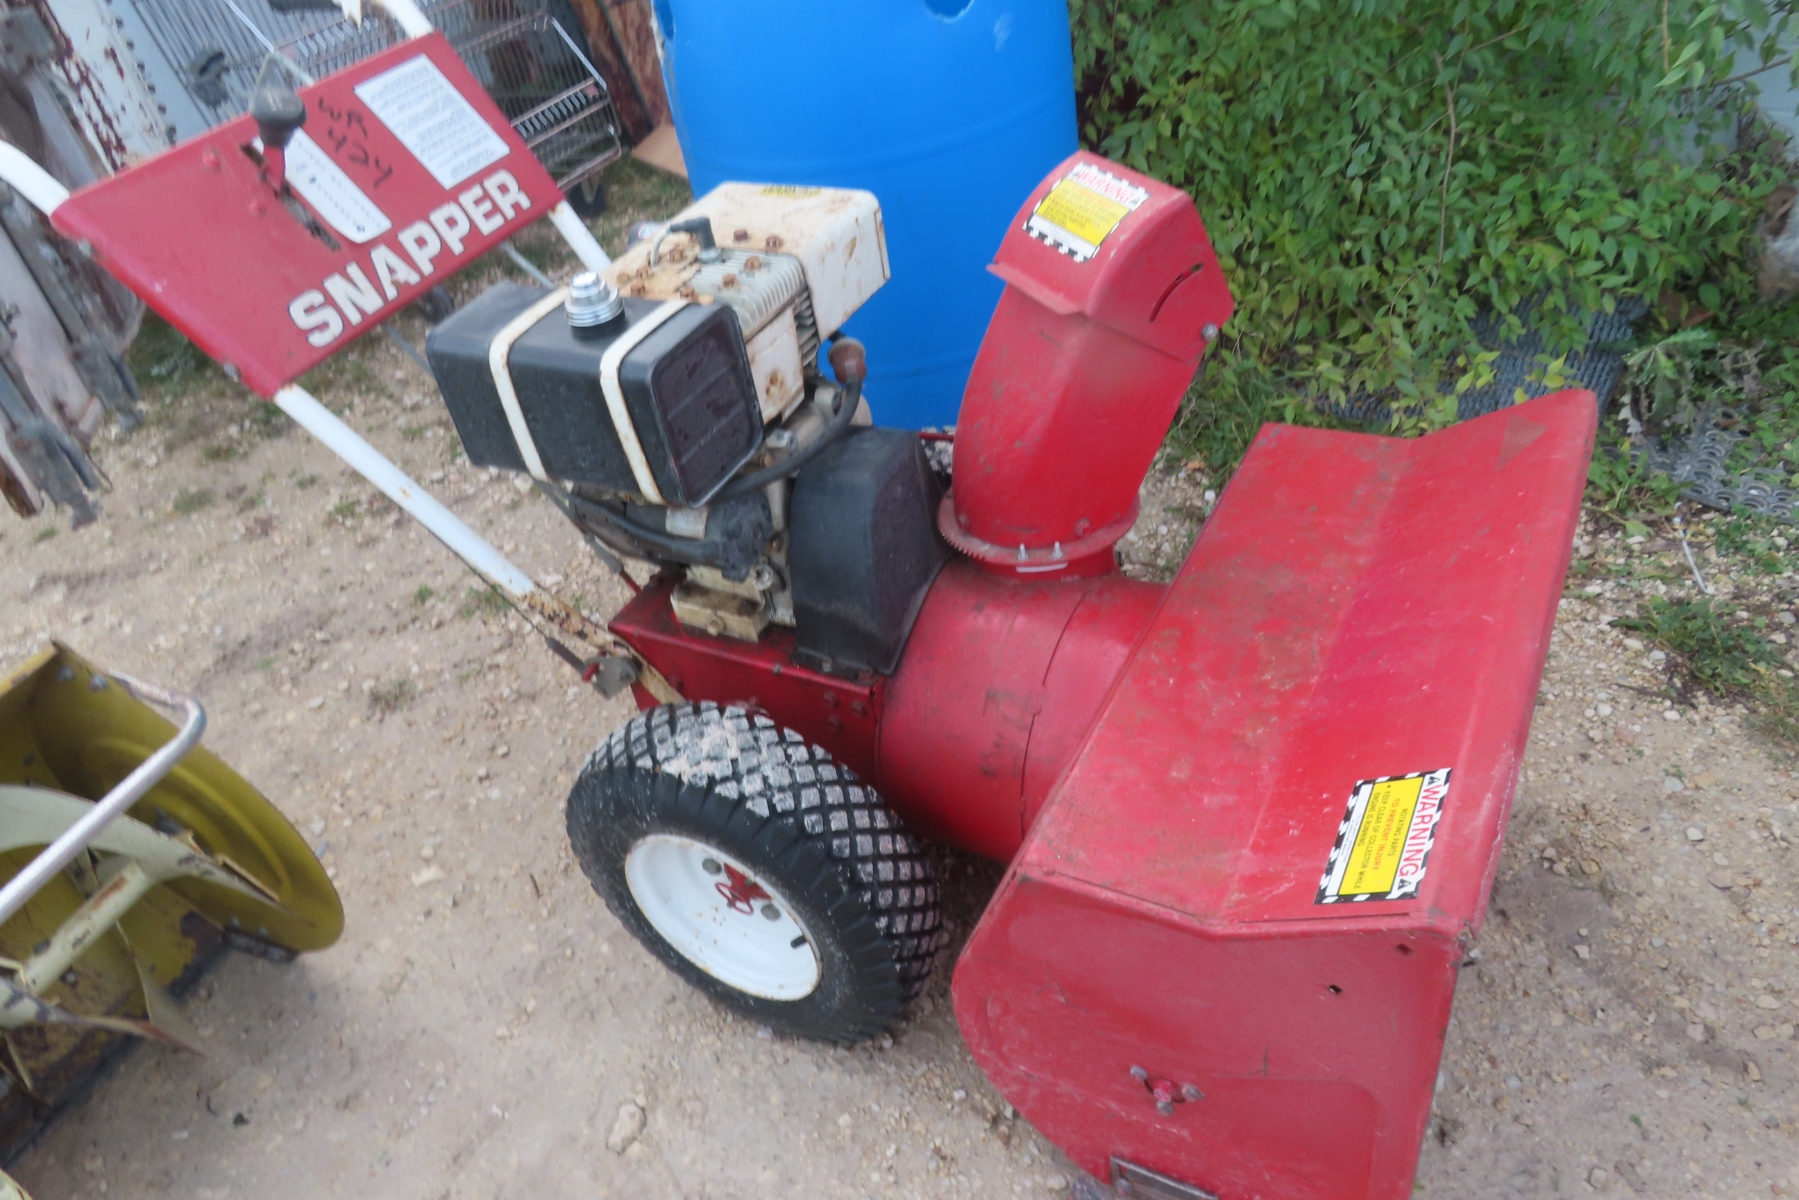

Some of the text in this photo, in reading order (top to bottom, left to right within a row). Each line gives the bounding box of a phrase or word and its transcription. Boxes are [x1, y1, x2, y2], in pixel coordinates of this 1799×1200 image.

[1077, 170, 1135, 203] WARNING
[288, 168, 532, 348] SNAPPER
[1368, 792, 1381, 812] ENGINE
[1388, 808, 1408, 857] ROTATING PARTS
[1398, 784, 1443, 877] WARNING
[1353, 791, 1391, 890] KEEP CLEAR OF COLLECTOR WHILE
[1357, 820, 1372, 846] RUNNING
[1372, 797, 1400, 870] TO PREVENT INJURY
